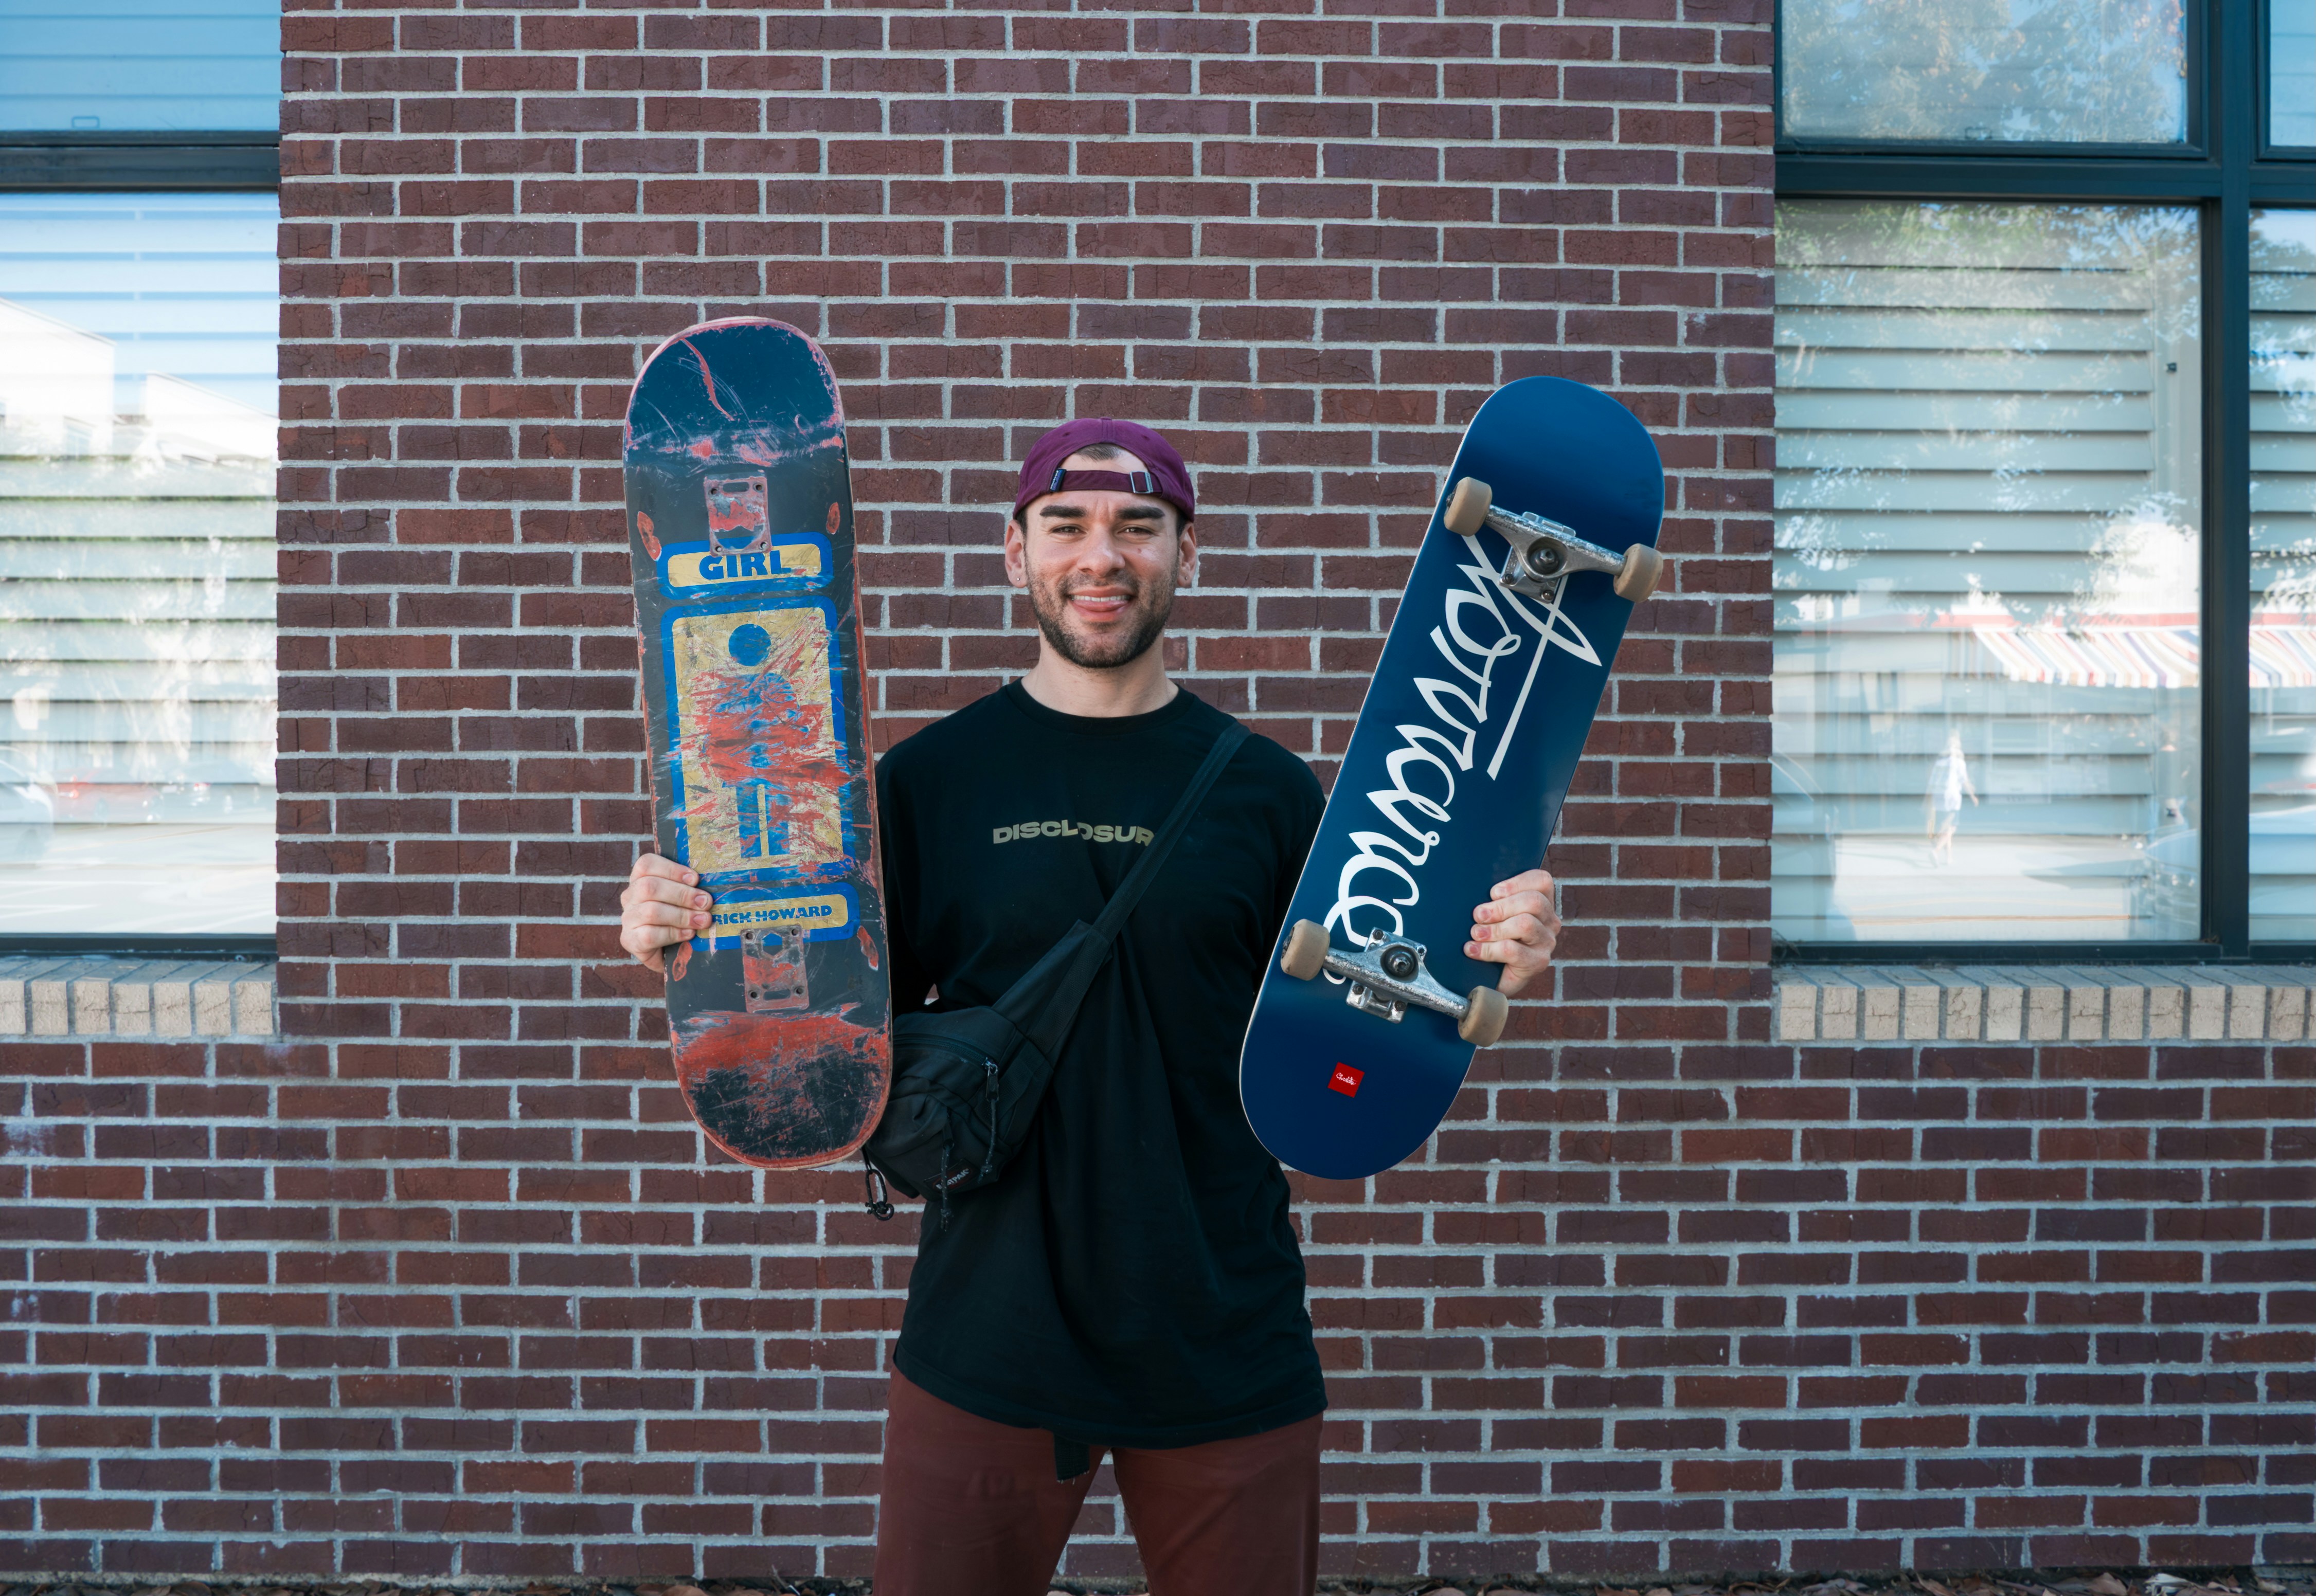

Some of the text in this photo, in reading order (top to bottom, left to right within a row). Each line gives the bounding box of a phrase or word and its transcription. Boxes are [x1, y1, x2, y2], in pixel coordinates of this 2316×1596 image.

[699, 550, 792, 580] GIRL
[993, 820, 1155, 846] DISCLOSUR
[712, 904, 833, 925] RICK HOWARD
